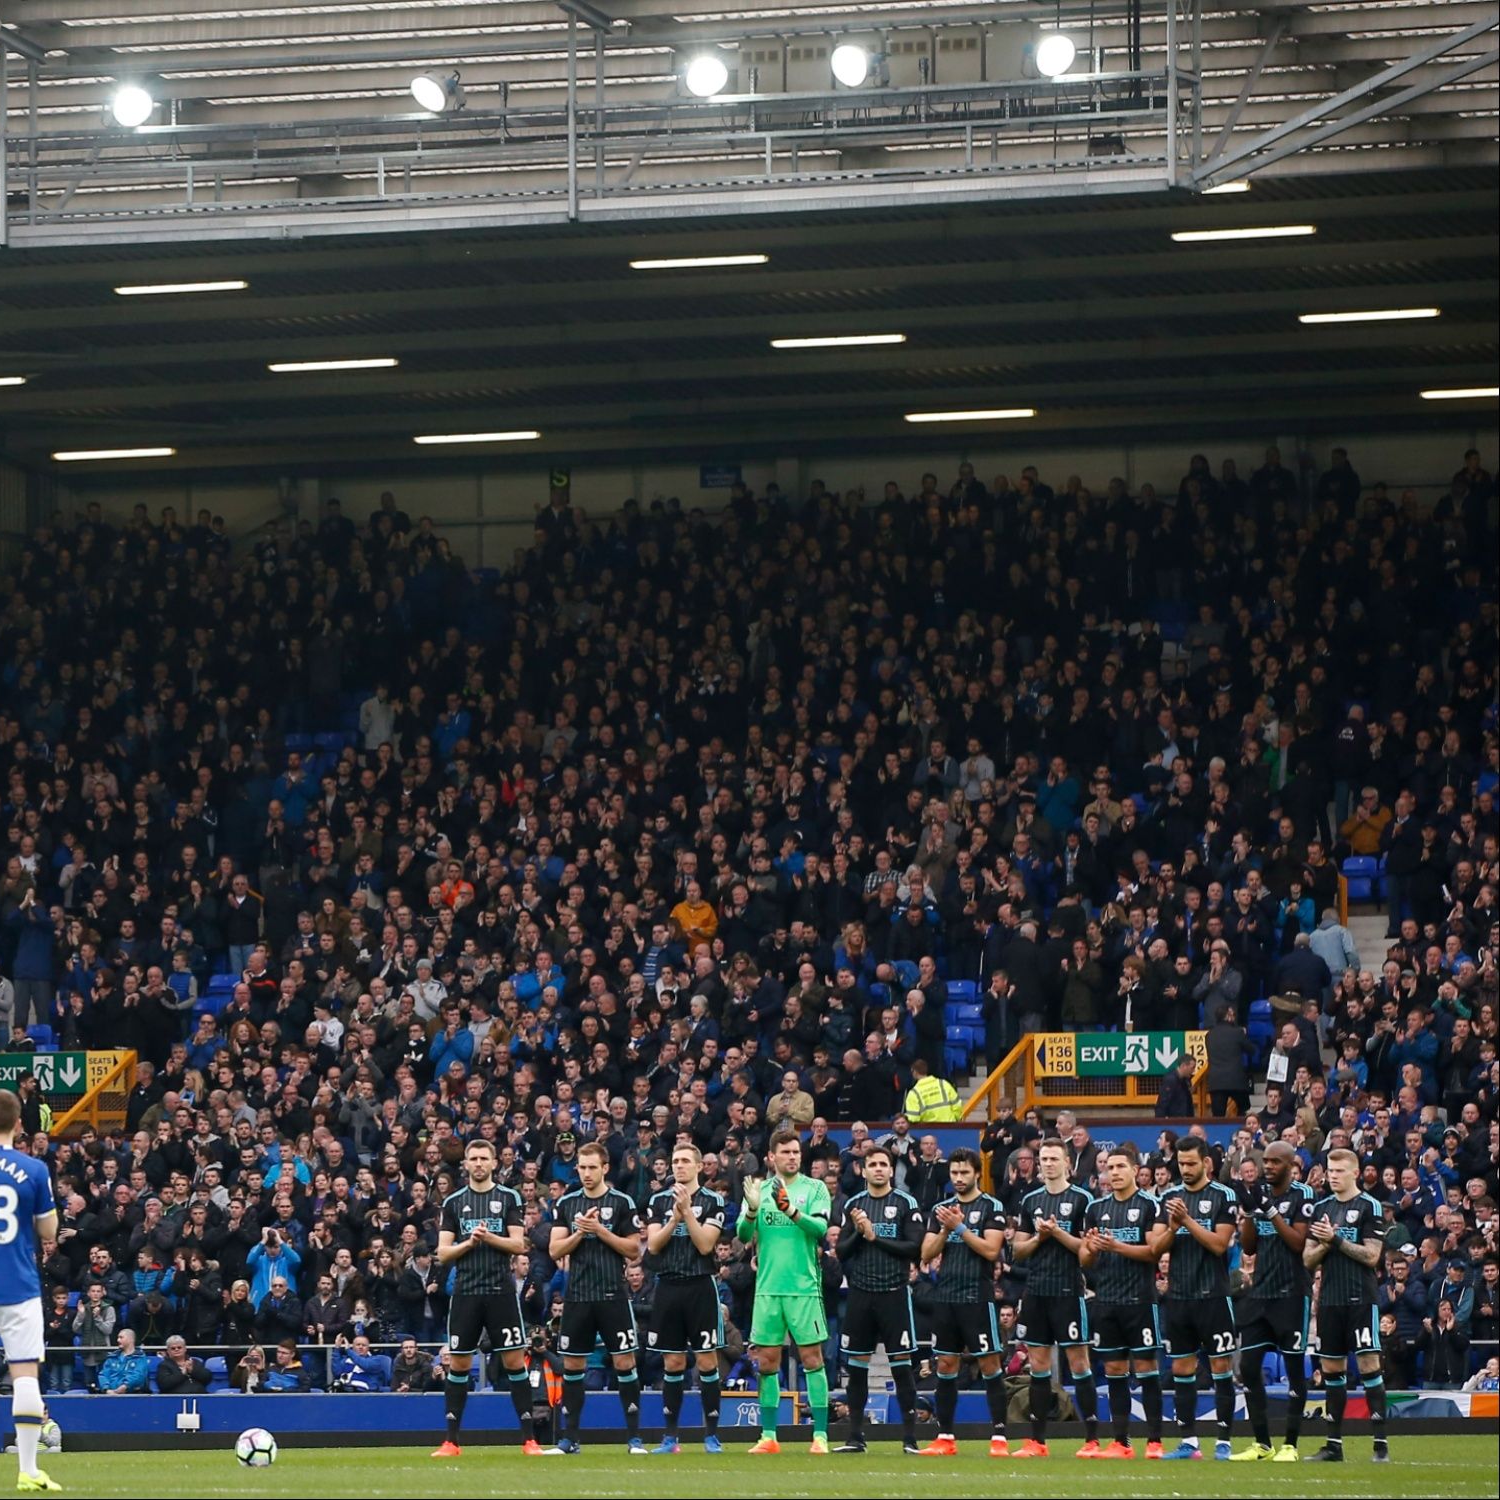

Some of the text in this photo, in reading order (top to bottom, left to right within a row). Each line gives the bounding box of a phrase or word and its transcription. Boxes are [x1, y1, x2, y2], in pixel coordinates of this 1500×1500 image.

[1048, 1036, 1073, 1044] SEATS
[1048, 1045, 1073, 1058] 136
[1081, 1046, 1119, 1062] EXIT
[1189, 1044, 1204, 1056] 12
[88, 1057, 112, 1065] SEATS
[1048, 1060, 1073, 1073] 150
[91, 1066, 108, 1076] 151
[501, 1326, 522, 1347] 23
[617, 1329, 636, 1350] 25
[700, 1329, 717, 1349] 24
[900, 1330, 911, 1349] 4
[1067, 1321, 1079, 1340] 6
[1141, 1327, 1154, 1347] 8
[1354, 1327, 1372, 1348] 14
[978, 1333, 989, 1352] 5
[1213, 1331, 1236, 1352] 22
